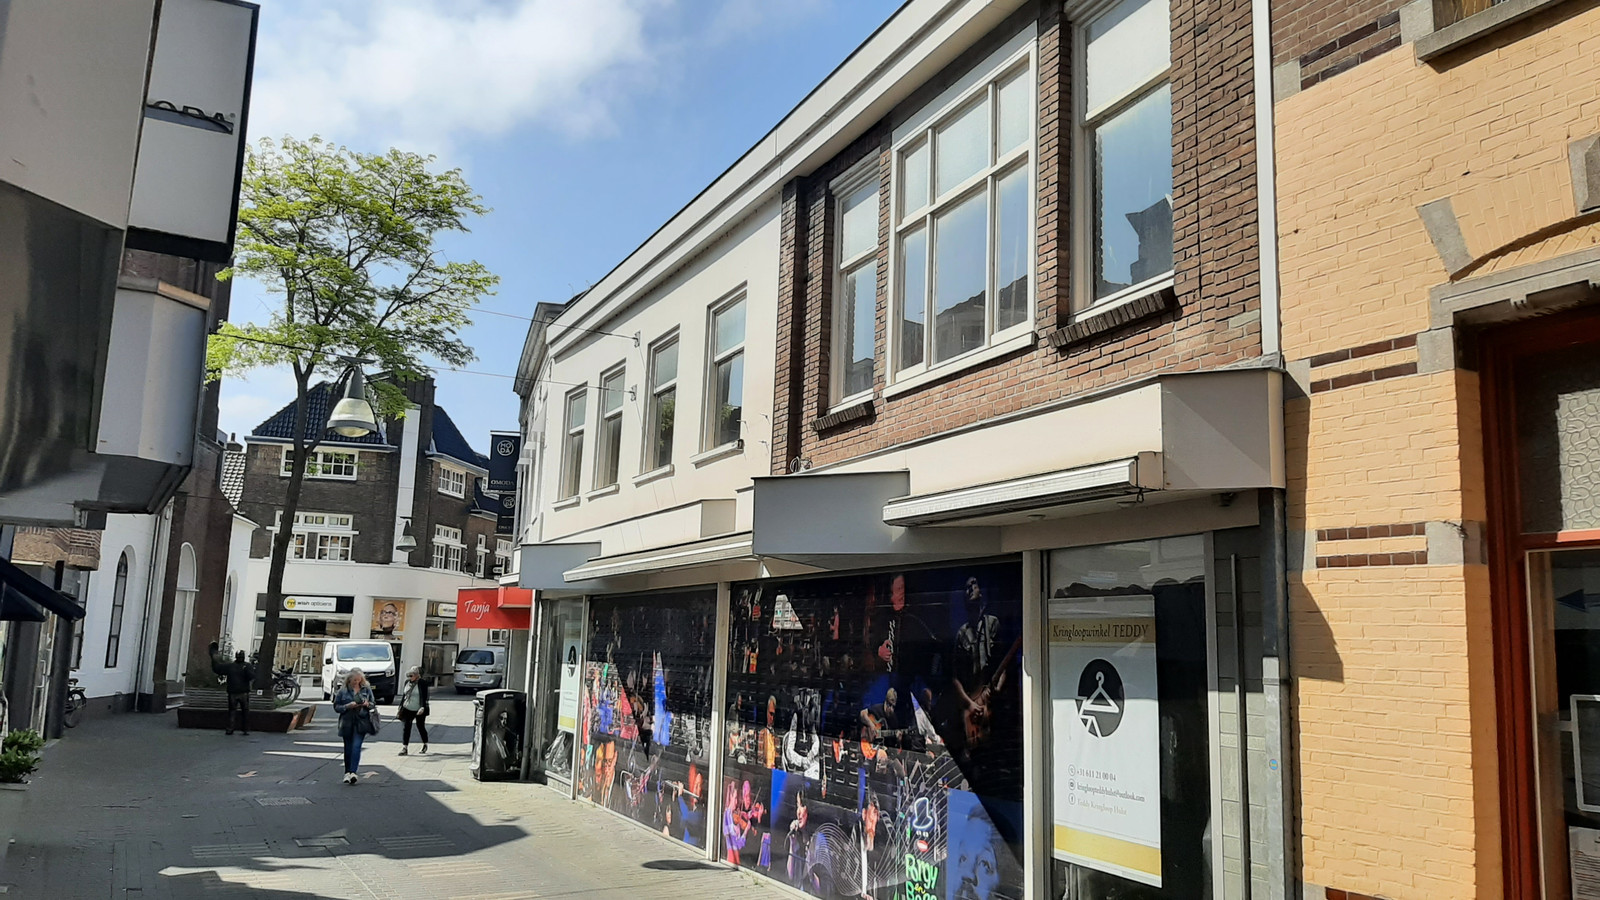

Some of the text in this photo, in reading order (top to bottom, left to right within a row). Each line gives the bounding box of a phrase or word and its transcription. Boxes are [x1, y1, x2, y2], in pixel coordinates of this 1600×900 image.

[464, 600, 490, 620] Tanja
[1052, 623, 1149, 641] Kringloopwinkel TEDDY
[904, 853, 939, 890] Porgy
